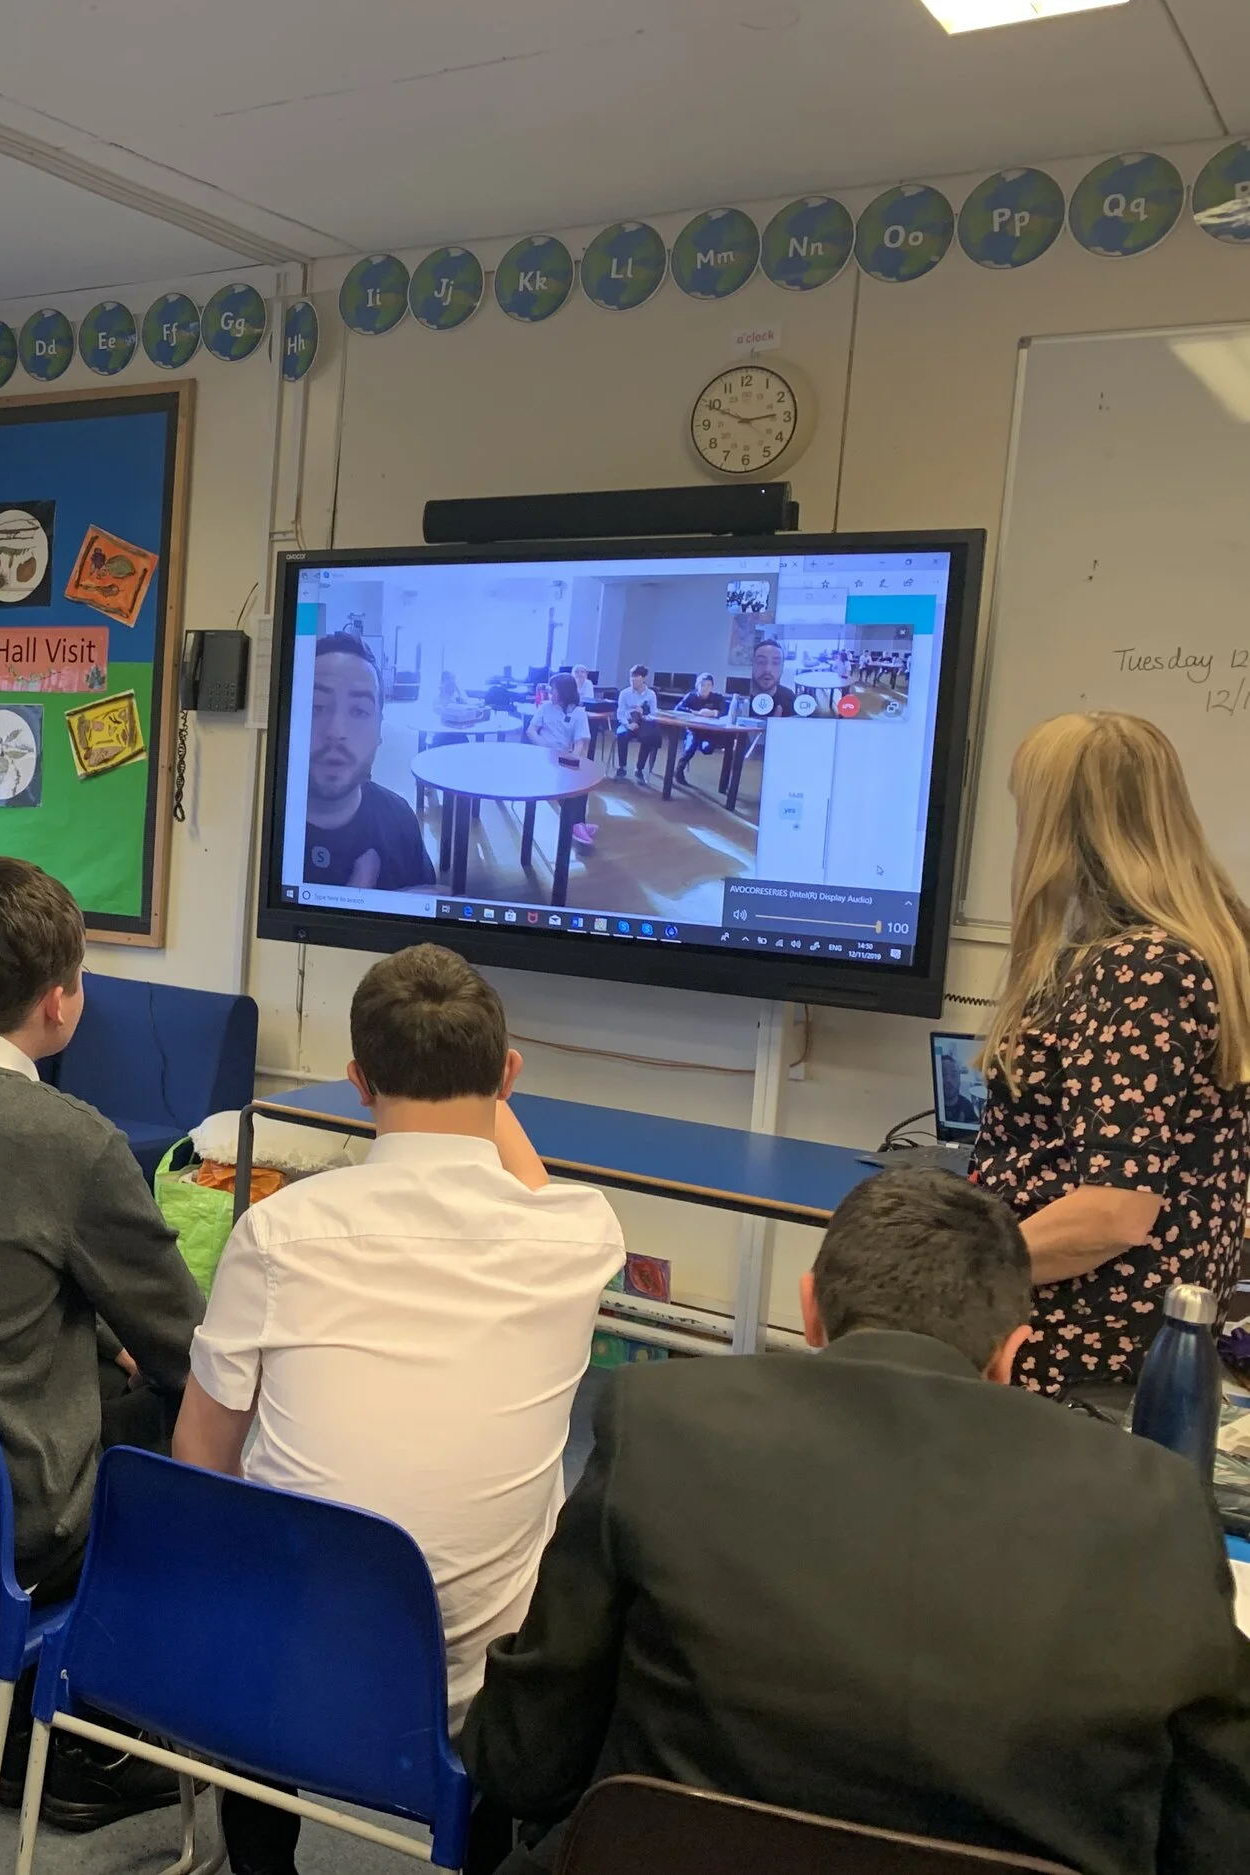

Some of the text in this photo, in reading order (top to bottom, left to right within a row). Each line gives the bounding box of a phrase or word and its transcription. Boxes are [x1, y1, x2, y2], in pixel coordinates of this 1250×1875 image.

[1103, 193, 1148, 222] Qq
[992, 208, 1031, 237] Pp
[883, 225, 923, 248] Oo
[788, 236, 824, 258] Nn
[610, 257, 634, 279] Ll
[696, 249, 736, 269] Mm
[518, 270, 548, 292] Kk
[366, 288, 381, 308] Ii
[434, 278, 455, 306] Jj
[162, 322, 179, 346] Ff
[220, 312, 246, 338] Gg
[98, 332, 117, 350] Ee
[286, 336, 306, 356] Hh
[736, 330, 775, 345] o'clock
[35, 339, 57, 356] Dd
[724, 383, 732, 394] 11
[740, 375, 753, 387] 12
[765, 378, 770, 390] 1
[708, 398, 721, 411] 10
[776, 391, 786, 403] 2
[702, 419, 711, 431] 9
[783, 410, 792, 423] 3
[709, 437, 718, 449] 8
[775, 431, 784, 443] 4
[722, 450, 731, 461] 7
[741, 454, 750, 466] 6
[762, 446, 772, 458] 5
[45, 638, 96, 663] Visit
[1113, 647, 1214, 684] Tuesday
[1206, 677, 1250, 716] 12/1
[729, 885, 788, 898] AVOCORESERIES
[819, 892, 846, 903] Display
[847, 895, 873, 905] Audio)
[887, 922, 909, 934] 100
[828, 944, 843, 952] ENG
